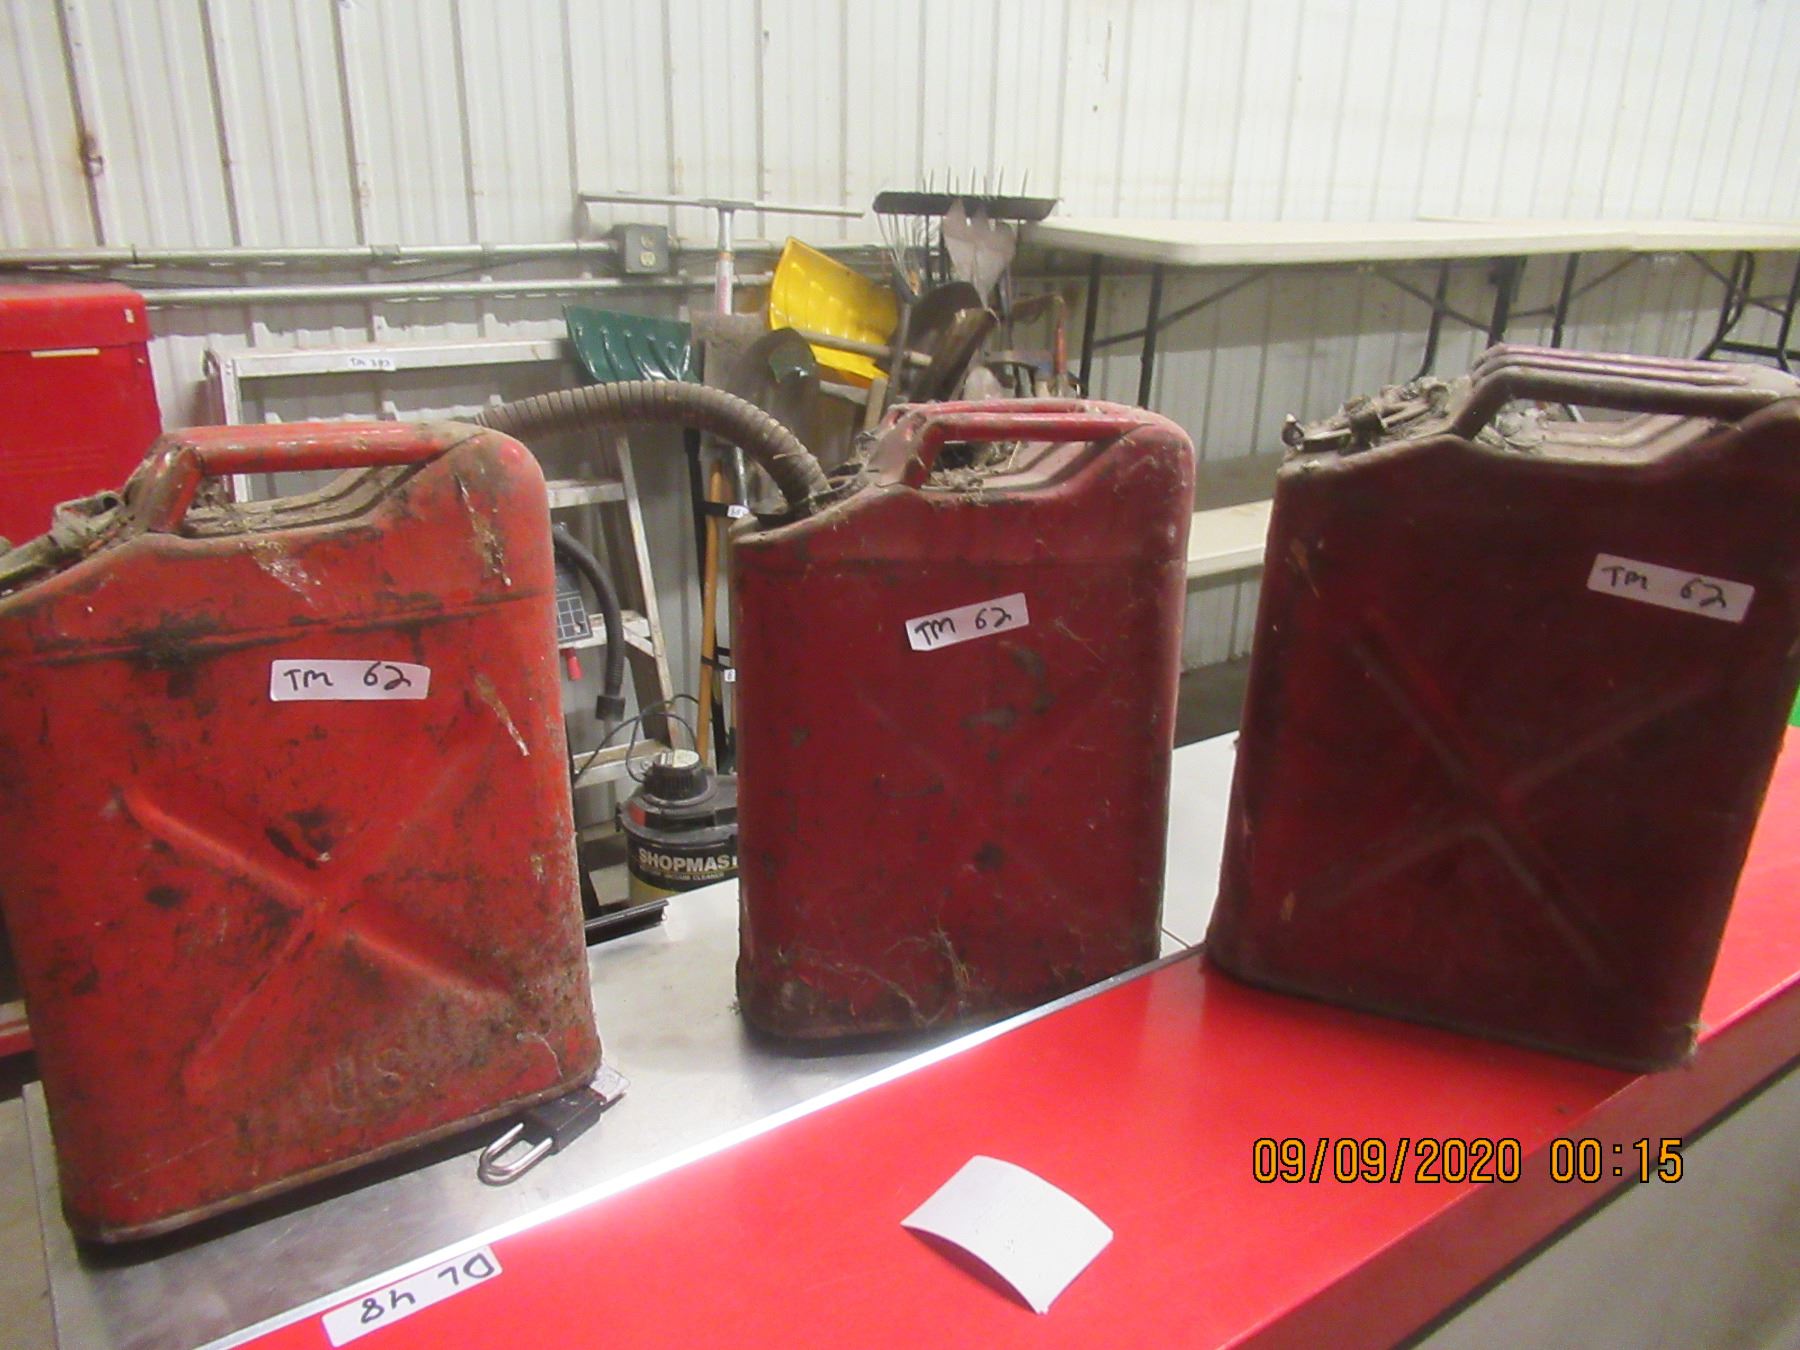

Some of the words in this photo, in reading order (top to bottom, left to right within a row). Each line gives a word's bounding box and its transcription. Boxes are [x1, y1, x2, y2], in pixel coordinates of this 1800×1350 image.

[1601, 566, 1648, 591] TM
[1680, 577, 1727, 608] 62
[914, 616, 956, 646] TM
[975, 606, 1012, 630] 62
[283, 669, 334, 691] TM
[363, 661, 412, 691] 62
